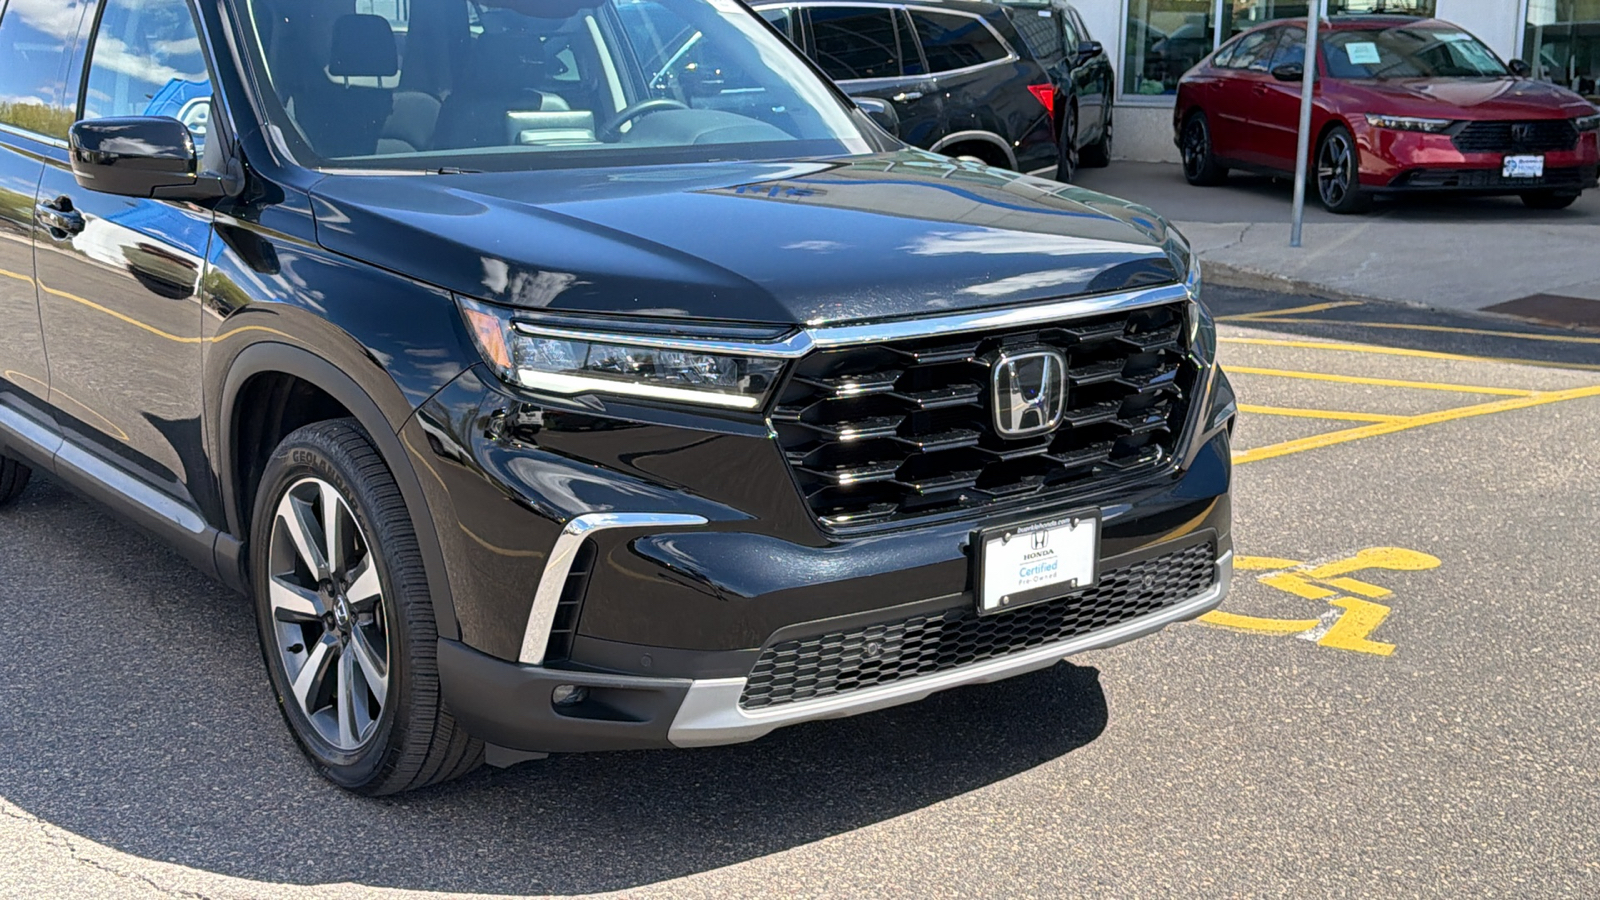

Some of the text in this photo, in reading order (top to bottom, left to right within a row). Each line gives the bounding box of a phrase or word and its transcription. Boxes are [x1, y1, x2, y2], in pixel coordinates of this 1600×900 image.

[1023, 549, 1054, 560] HONDA
[1019, 560, 1058, 577] Certified
[1018, 572, 1057, 585] Pre-Owned
